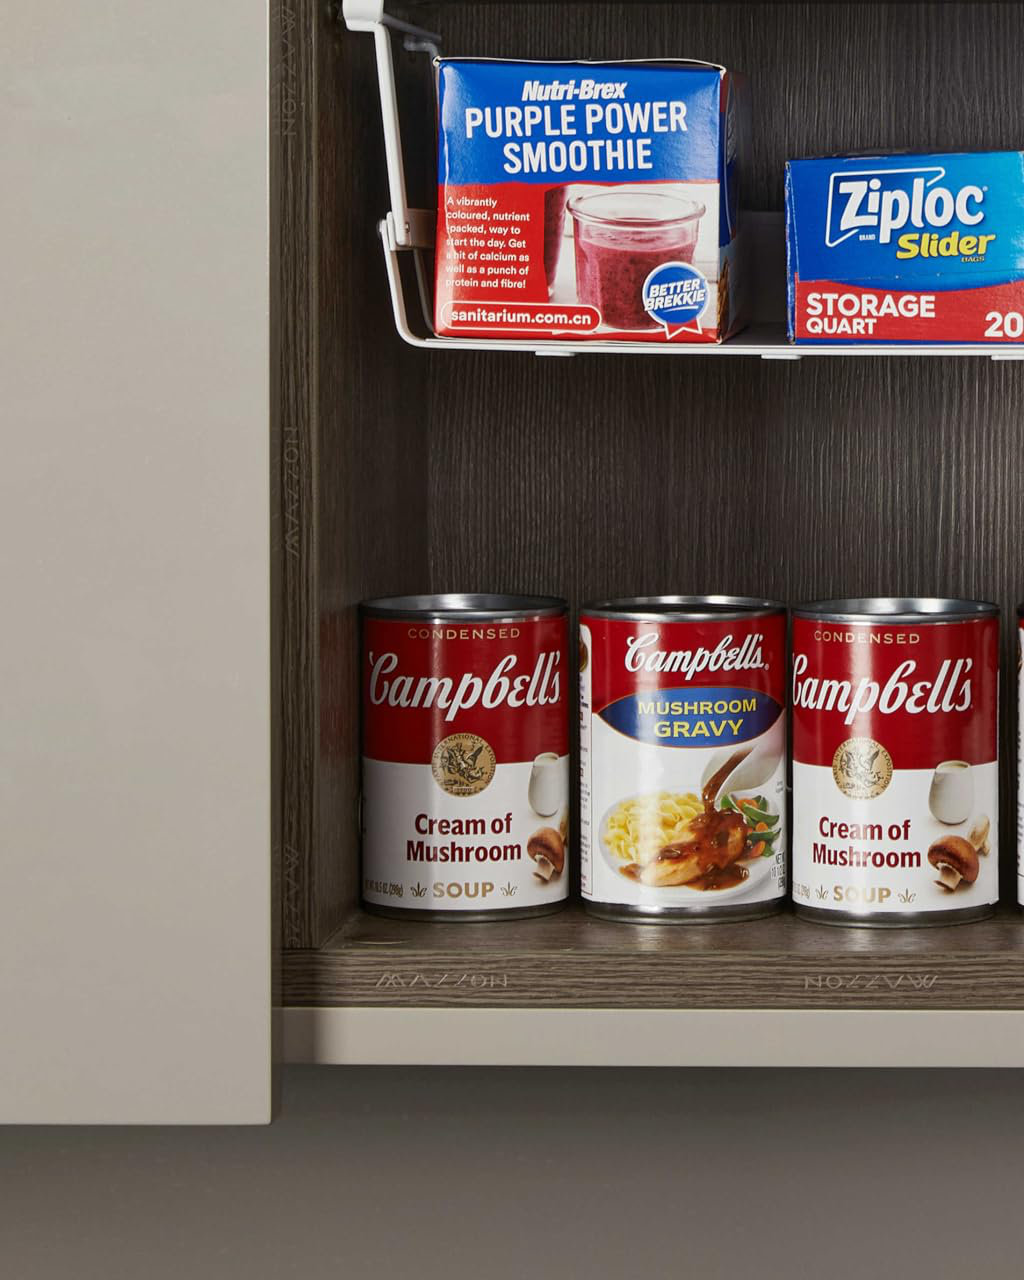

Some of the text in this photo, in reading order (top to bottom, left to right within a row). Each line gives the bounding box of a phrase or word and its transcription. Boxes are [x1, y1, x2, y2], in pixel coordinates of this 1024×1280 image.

[521, 79, 627, 101] Nutri-Brex
[465, 101, 688, 139] PURPLE POWER
[503, 138, 653, 174] SMOOTHIE
[447, 196, 498, 209] A vibrantly
[839, 177, 985, 244] Ziploc
[446, 211, 530, 222] coloured, nutrient
[489, 226, 509, 236] way
[511, 226, 521, 235] to
[446, 238, 527, 249] start the day. Get
[896, 231, 996, 260] Slider
[468, 251, 478, 260] of
[480, 251, 517, 261] calcium
[519, 254, 530, 262] as
[446, 264, 529, 276] well as a punch of
[446, 277, 527, 289] protein and fibre!
[650, 278, 701, 298] BETTER
[645, 289, 706, 311] BREKKIE
[806, 292, 936, 319] STORAGE
[451, 307, 592, 326] sanitarium.com.cn
[806, 317, 877, 335] QUART
[984, 312, 1024, 337] 20
[408, 627, 521, 640] CONDENSED
[814, 630, 920, 645] CONDENSED
[624, 632, 764, 681] Campbell's
[369, 650, 561, 722] Campbell's
[638, 697, 757, 716] MUSHROOM
[654, 719, 744, 738] GRAVY
[414, 812, 513, 836] Cream of
[819, 816, 911, 841] Cream of
[406, 840, 522, 864] Mushroom
[812, 842, 922, 868] Mushroom
[432, 881, 495, 899] SOUP
[833, 885, 892, 904] SOUP
